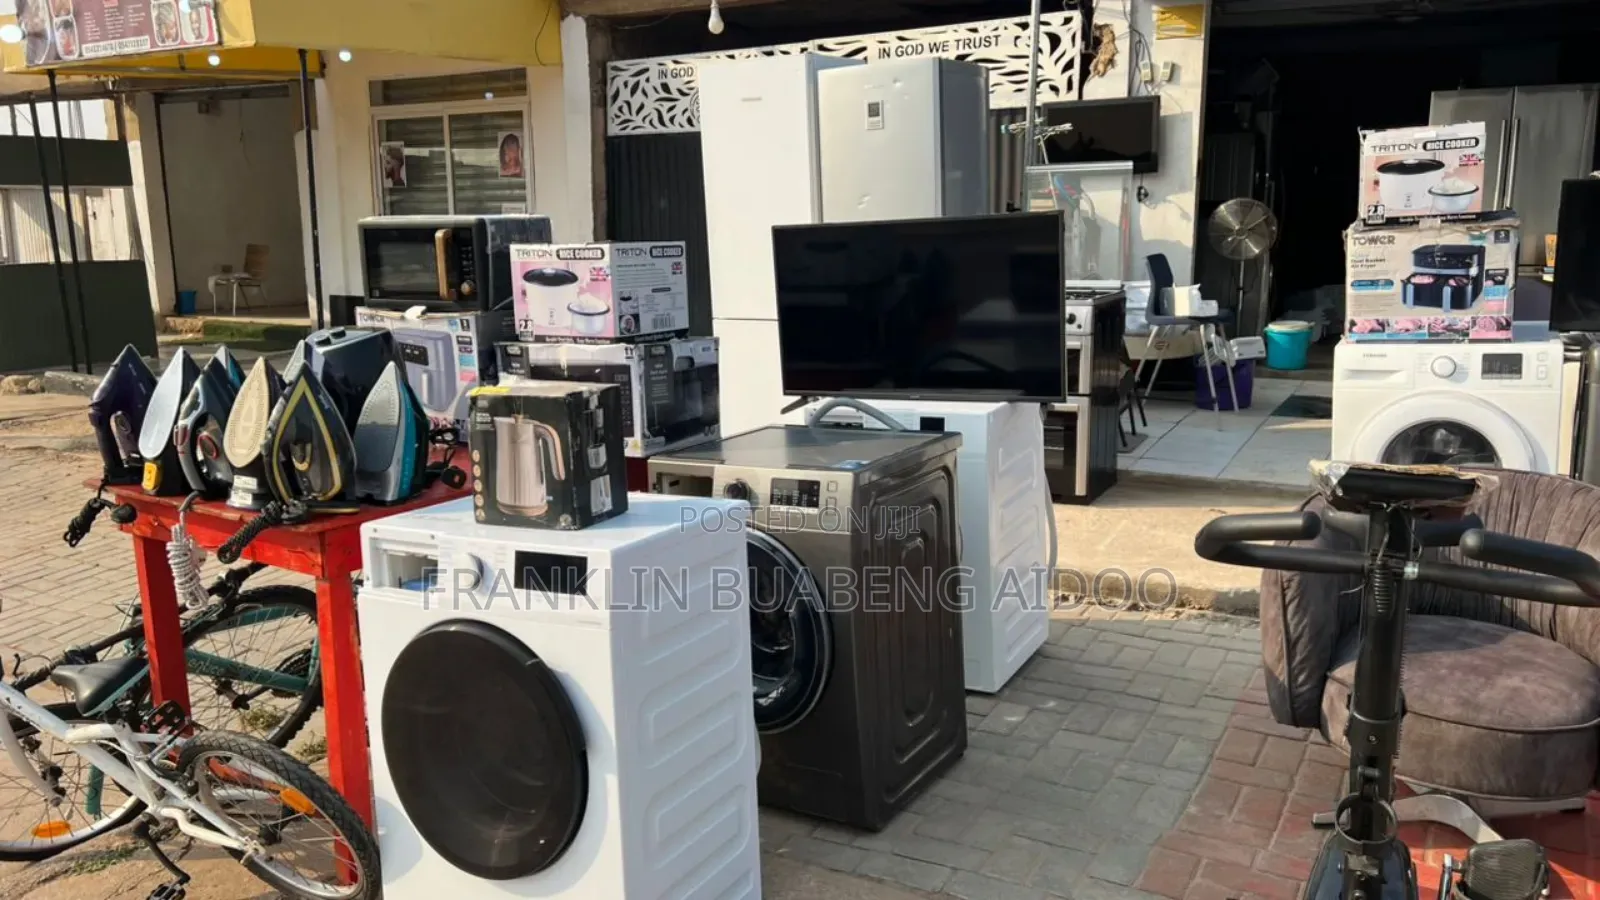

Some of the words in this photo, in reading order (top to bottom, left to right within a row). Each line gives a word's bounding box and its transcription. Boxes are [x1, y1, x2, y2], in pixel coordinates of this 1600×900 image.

[878, 46, 891, 60] IN
[894, 43, 925, 58] GOD
[928, 40, 950, 54] WE
[954, 34, 1002, 51] TRUST
[657, 68, 668, 80] IN
[670, 66, 695, 79] GOD
[1370, 143, 1417, 153] TRITON
[1425, 140, 1443, 150] RICE
[1444, 138, 1476, 149] COOKER
[516, 248, 552, 259] TRITON
[559, 248, 574, 258] RICE
[574, 248, 602, 259] COOKER
[616, 247, 647, 257] TRITON
